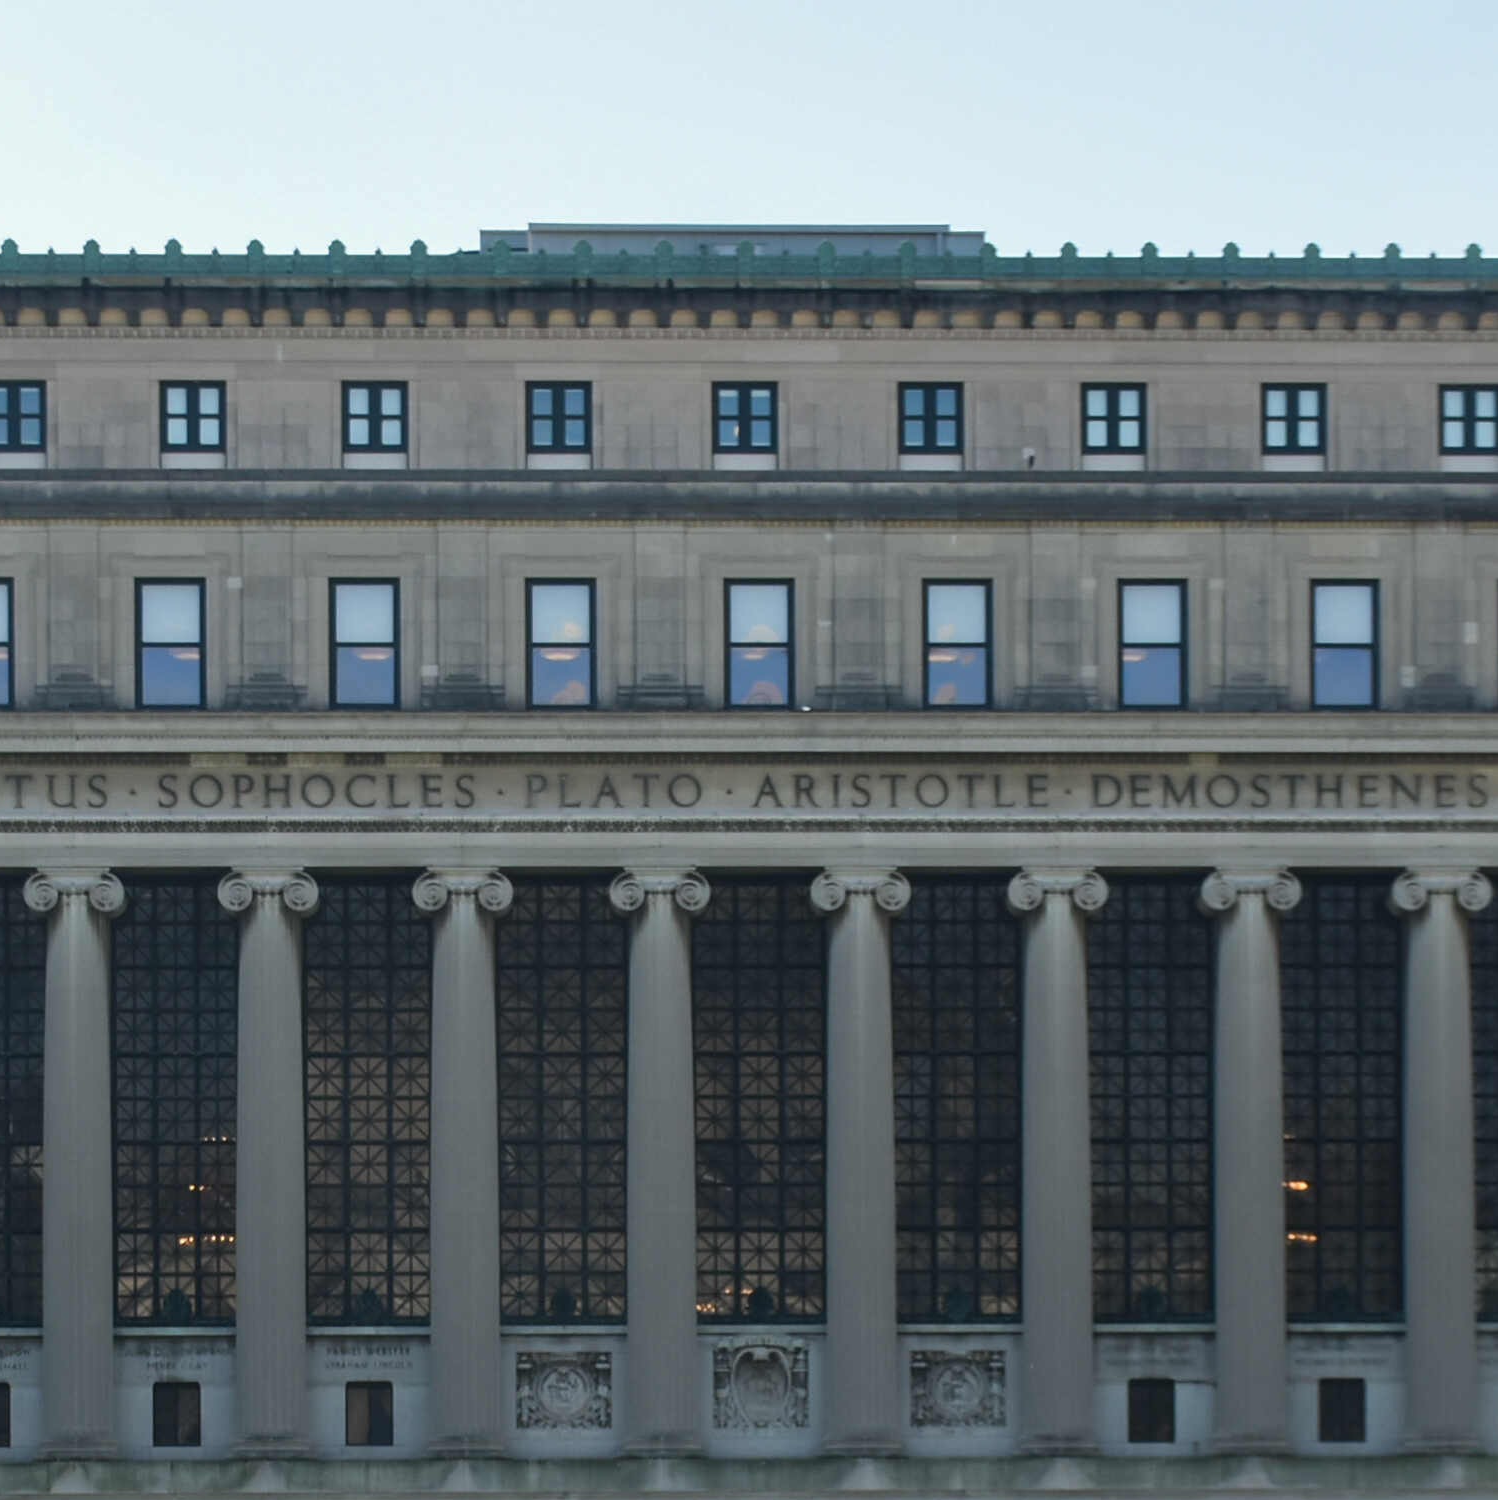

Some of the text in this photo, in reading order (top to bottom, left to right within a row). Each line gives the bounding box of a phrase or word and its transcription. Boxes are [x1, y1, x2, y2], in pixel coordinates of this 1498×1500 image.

[157, 773, 478, 810] SOPHOCLES
[525, 774, 704, 810] PLATO
[752, 774, 1049, 810] ARISTOTLE
[1089, 773, 1490, 810] DEMOSTHENES
